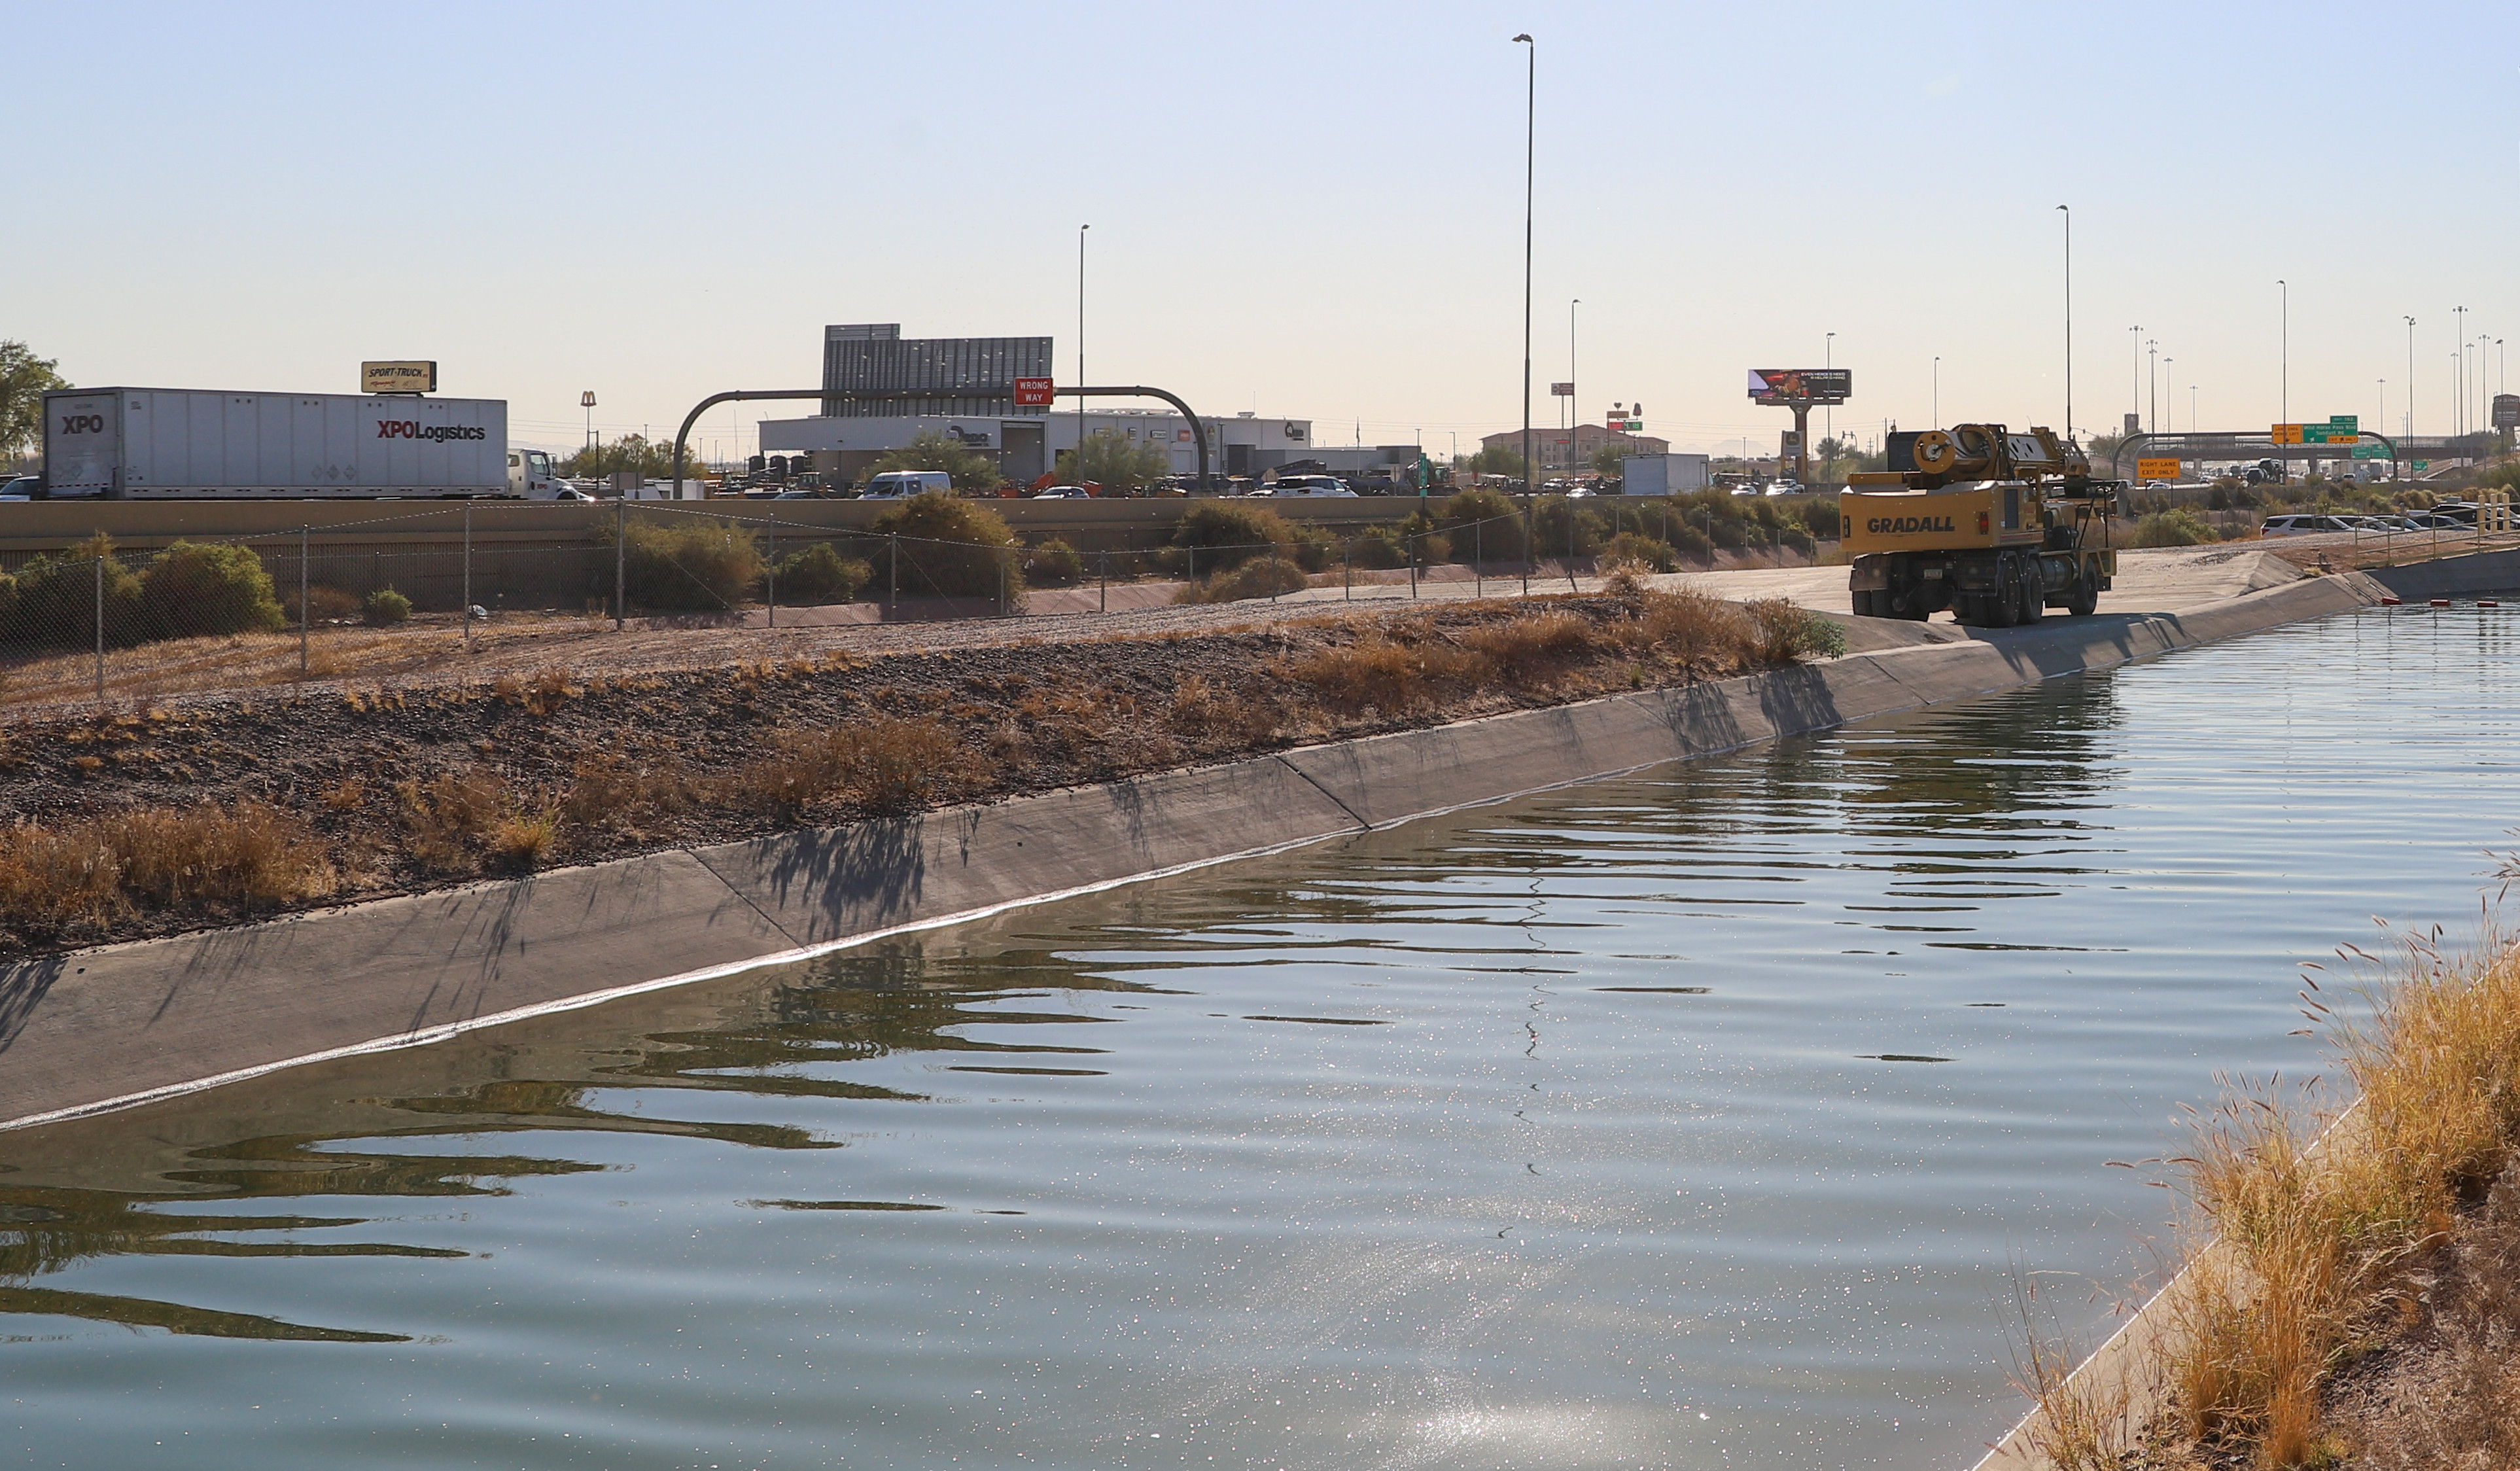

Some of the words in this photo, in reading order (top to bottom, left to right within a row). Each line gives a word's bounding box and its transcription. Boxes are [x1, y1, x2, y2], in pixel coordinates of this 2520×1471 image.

[1019, 381, 1049, 390] WRONG
[1024, 393, 1043, 402] WAY
[61, 414, 104, 434] XPO
[1867, 516, 1955, 533] GRADALL
